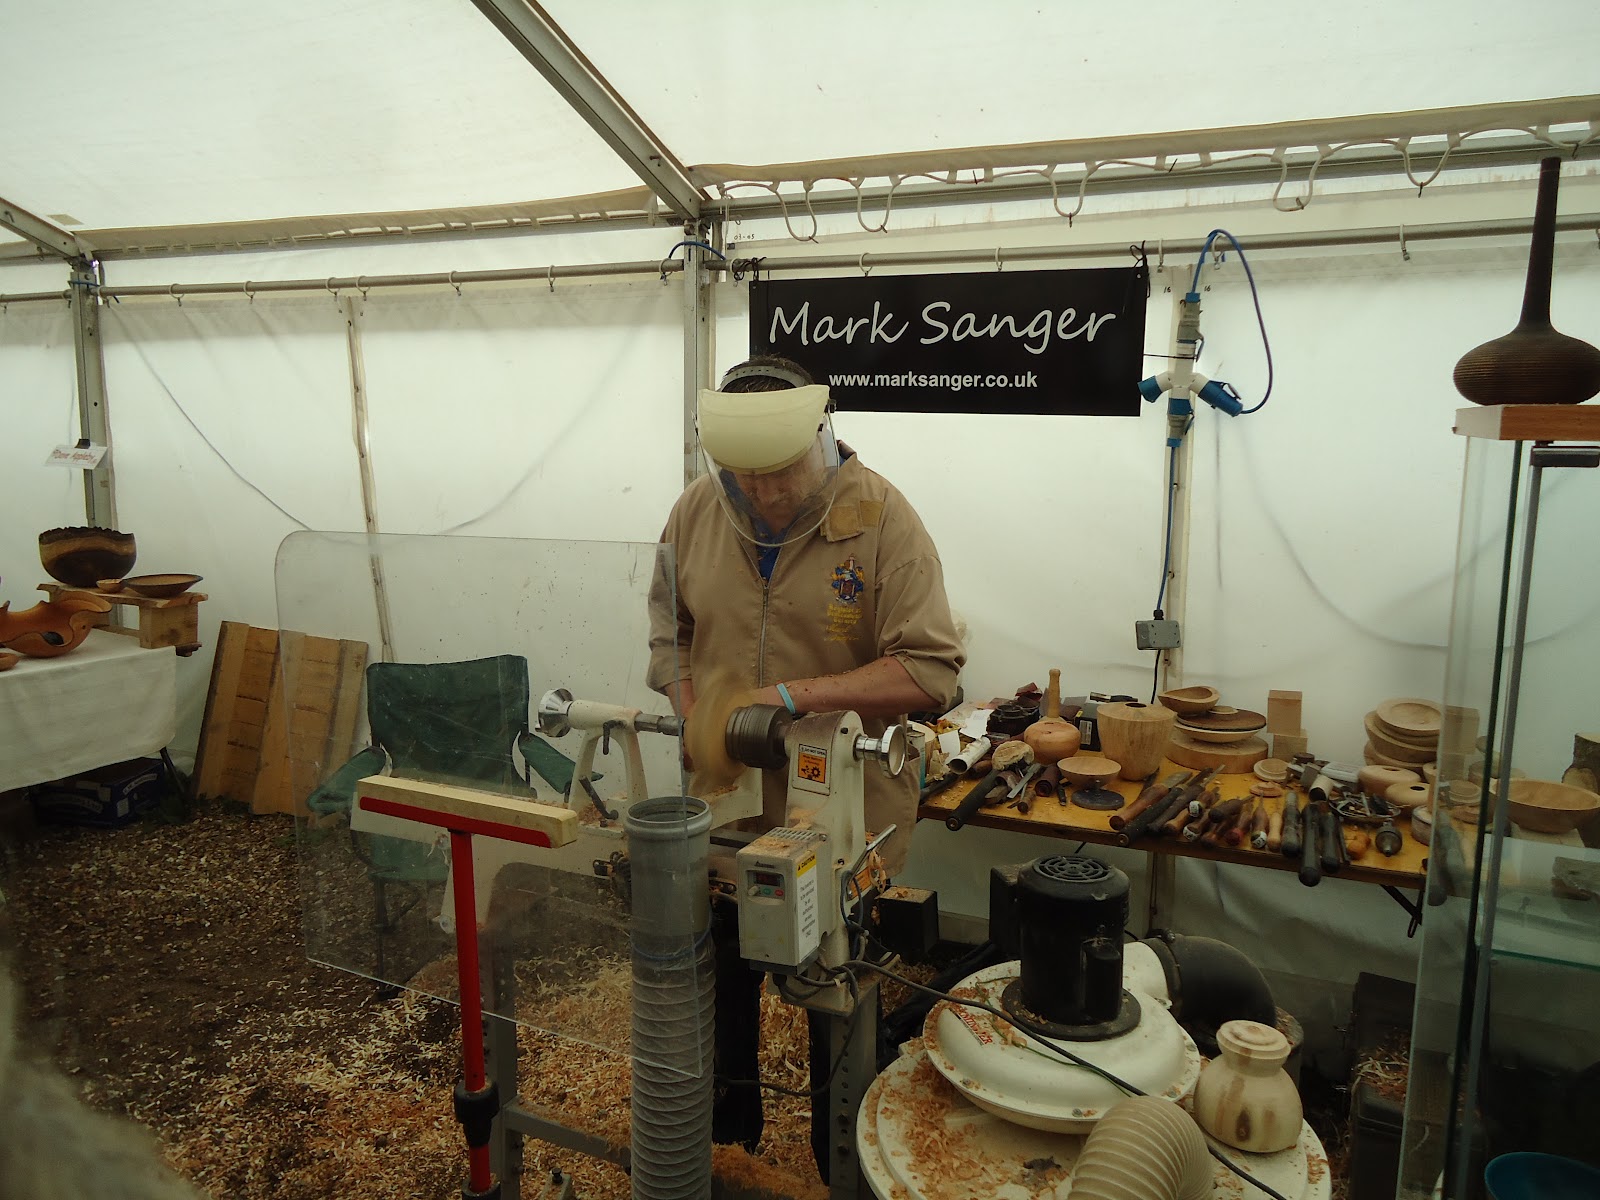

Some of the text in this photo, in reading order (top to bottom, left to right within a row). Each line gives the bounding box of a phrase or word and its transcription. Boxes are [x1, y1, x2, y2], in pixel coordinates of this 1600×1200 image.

[769, 301, 1116, 355] Mark Sanger
[828, 371, 1038, 391] www.marksanger.co.uk
